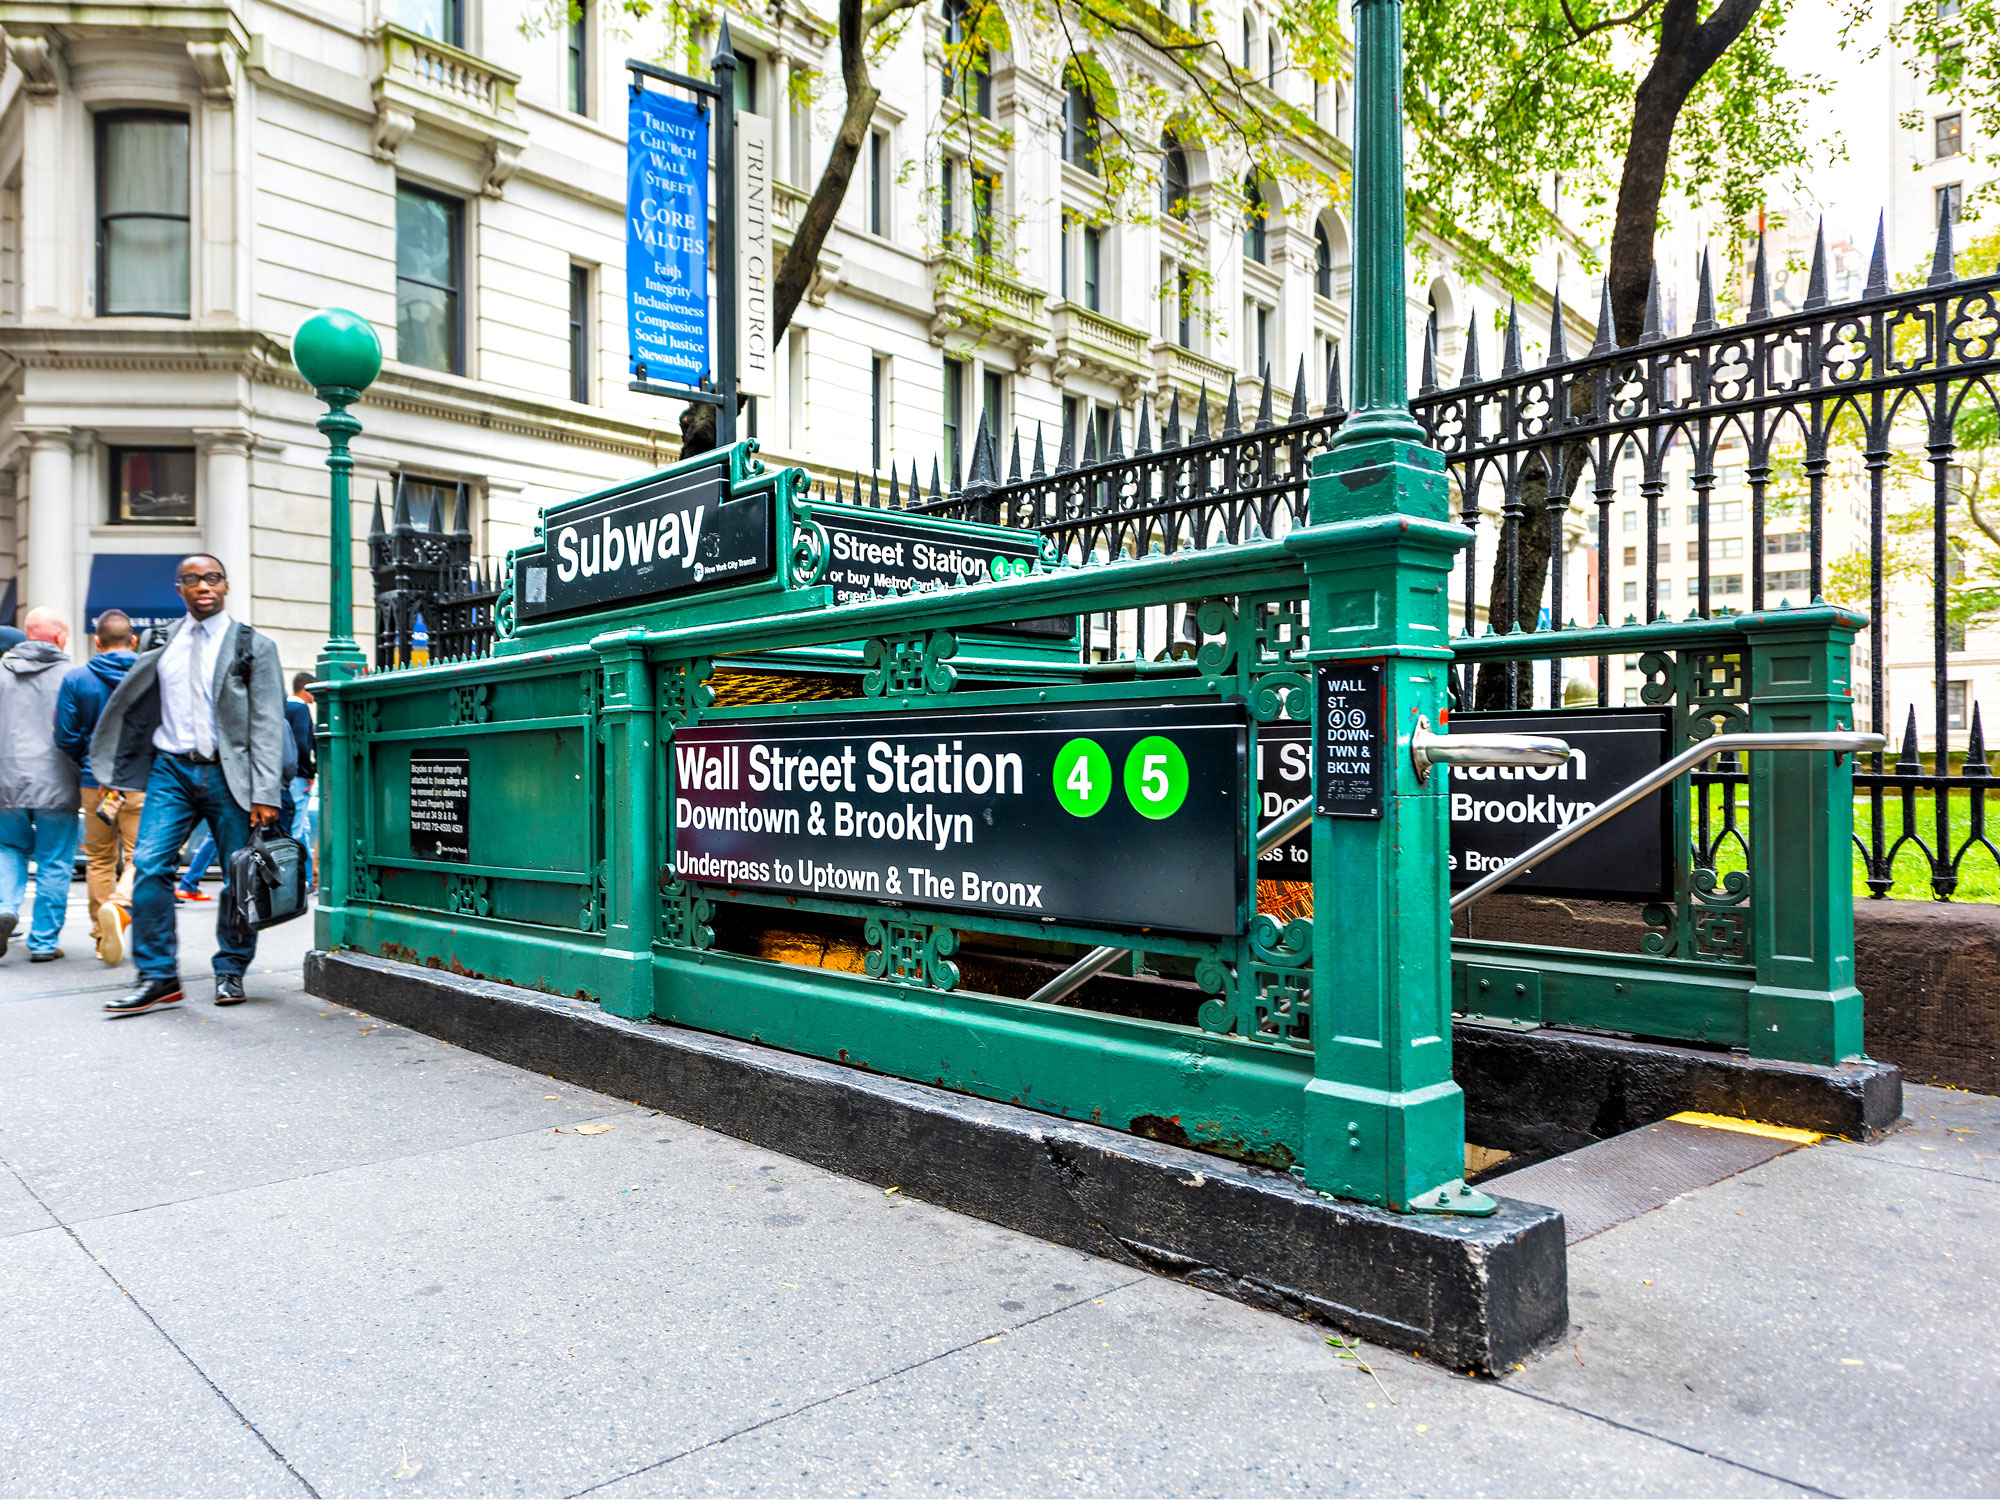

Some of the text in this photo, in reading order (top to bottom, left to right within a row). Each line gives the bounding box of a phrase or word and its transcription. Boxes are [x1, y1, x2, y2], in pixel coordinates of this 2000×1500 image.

[643, 111, 696, 141] TRINITY
[640, 131, 697, 159] CHURCH
[650, 152, 687, 176] WALL
[646, 171, 694, 196] STREET
[640, 198, 696, 230] CORE
[632, 218, 704, 254] VALUES
[747, 140, 765, 371] TRINITY CHURCH
[654, 262, 682, 279] Faith
[645, 277, 692, 300] Integrity
[634, 292, 704, 317] Inclusiveness
[635, 311, 702, 337] Compassion
[635, 328, 704, 353] Social Justice
[638, 346, 702, 373] Stewardship
[557, 505, 705, 582] Subway
[833, 532, 904, 567] Street
[912, 543, 987, 577] Station
[830, 570, 844, 583] or
[848, 570, 870, 588] buy
[1327, 680, 1366, 692] WALL
[1327, 696, 1349, 708] ST.
[1327, 729, 1374, 741] DOWN-
[1327, 746, 1371, 758] TWN &
[676, 740, 1169, 802] Wall Street Station 4 5
[1327, 762, 1370, 774] BKLYN
[676, 798, 974, 851] Downtown & Brooklyn
[1290, 845, 1309, 863] to
[676, 850, 1043, 908] Underpass to Uptown & The Bronx
